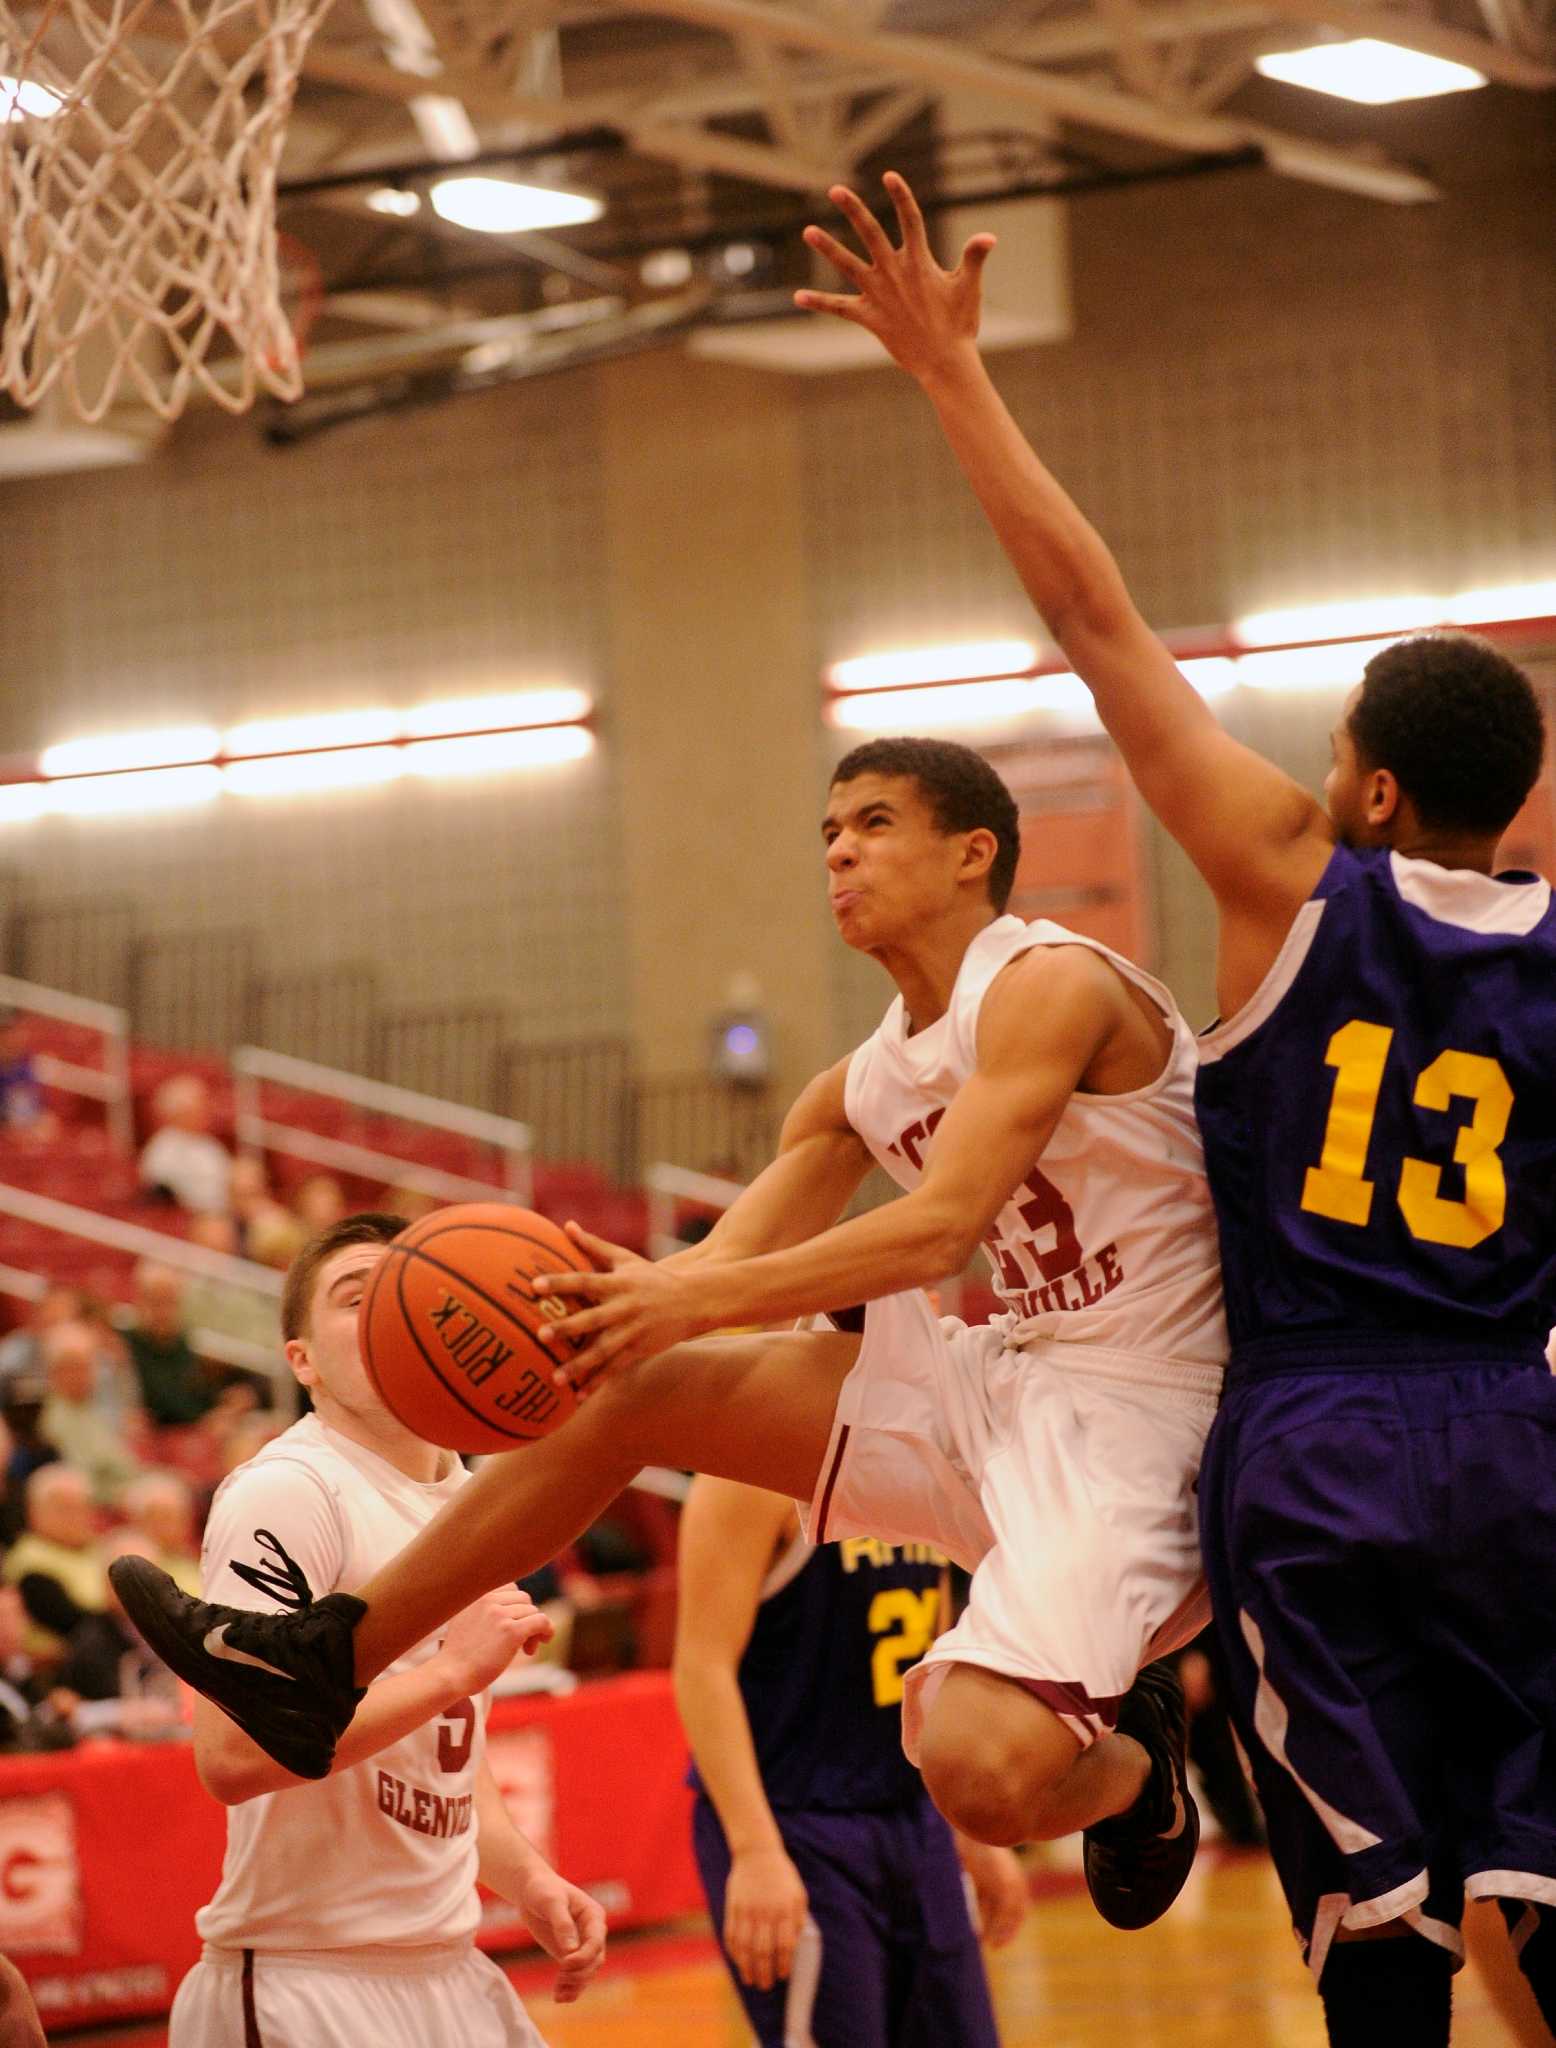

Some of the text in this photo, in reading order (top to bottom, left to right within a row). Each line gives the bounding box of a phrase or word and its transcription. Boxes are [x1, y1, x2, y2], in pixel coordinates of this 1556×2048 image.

[1300, 1019, 1515, 1250] 13
[431, 1295, 513, 1388] ROCK
[495, 1369, 560, 1424] THE
